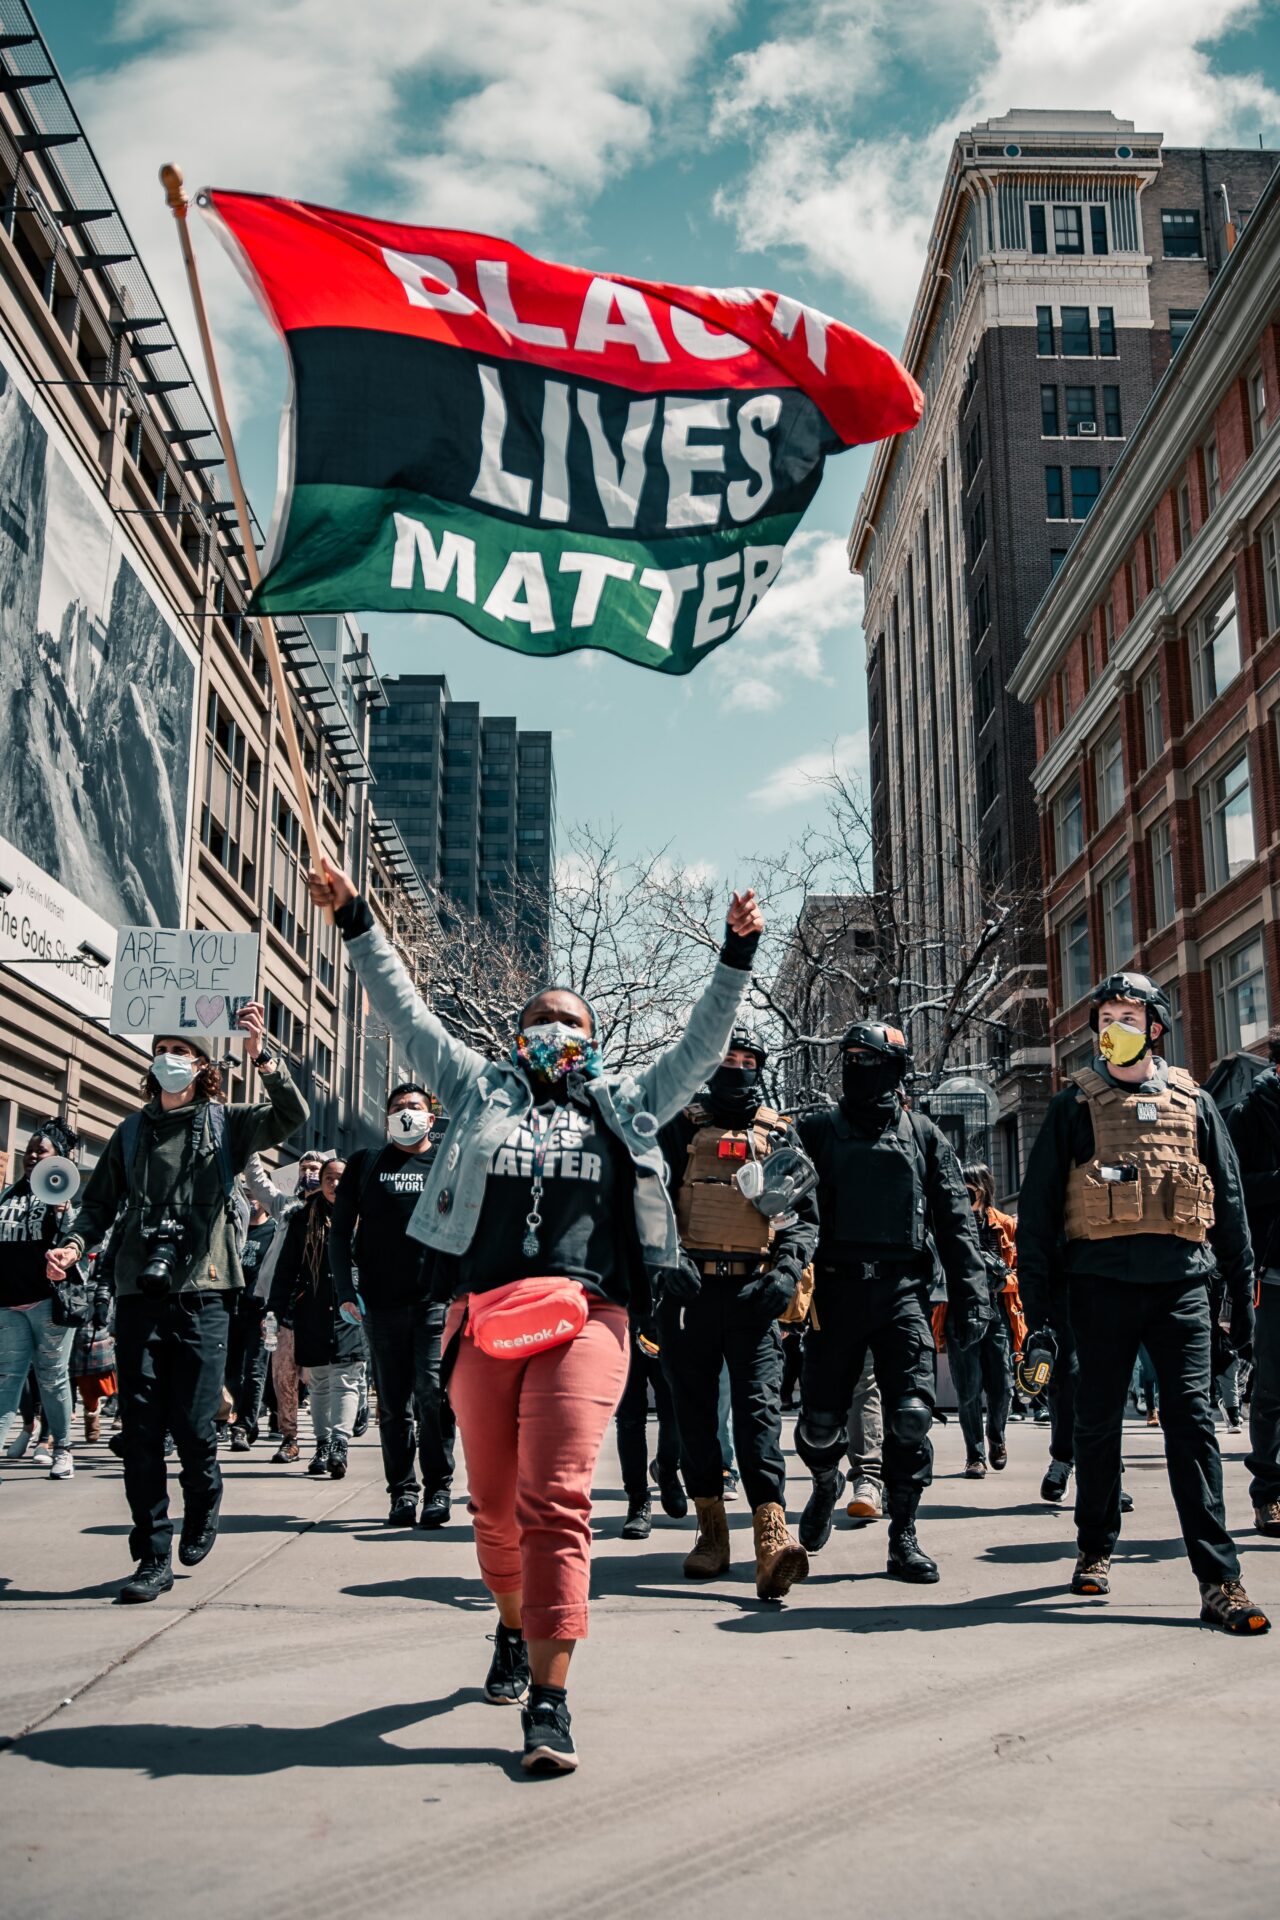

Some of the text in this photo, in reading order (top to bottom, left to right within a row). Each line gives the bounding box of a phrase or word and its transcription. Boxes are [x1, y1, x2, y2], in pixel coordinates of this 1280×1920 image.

[470, 363, 783, 530] LIVES
[390, 512, 784, 649] MATTER
[16, 872, 25, 895] by
[26, 880, 43, 906] Kevin
[0, 900, 18, 939] he
[21, 915, 53, 961] Gods
[80, 964, 93, 990] on
[120, 931, 237, 965] ARE YOU
[123, 966, 230, 992] CAPABLE
[126, 995, 166, 1029] OF
[379, 1172, 424, 1182] UNFUCK
[395, 1181, 425, 1192] WORL
[492, 1328, 554, 1349] Reebok
